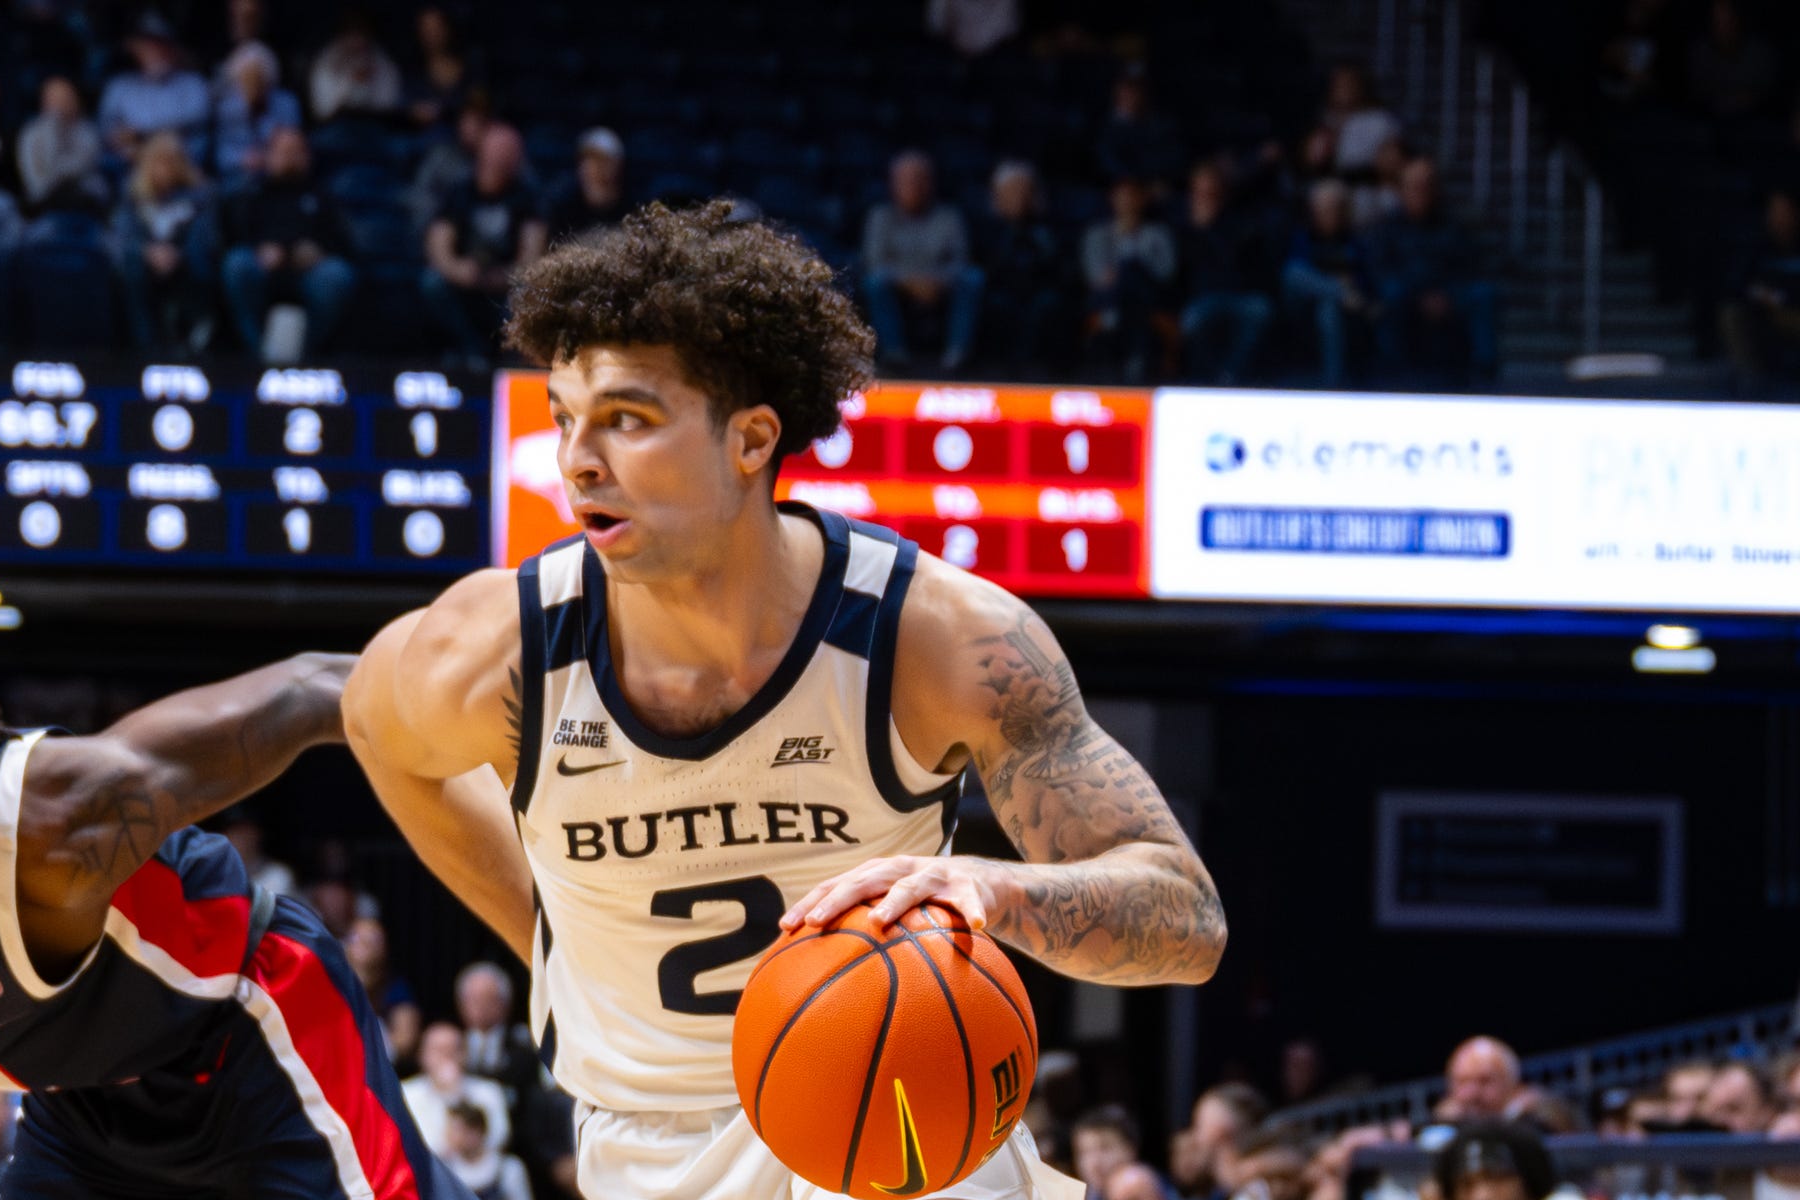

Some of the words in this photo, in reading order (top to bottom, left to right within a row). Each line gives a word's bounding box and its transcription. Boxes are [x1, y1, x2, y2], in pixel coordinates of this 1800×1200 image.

[558, 718, 577, 733] BE
[580, 720, 608, 736] THE
[553, 732, 609, 748] CHANGE
[779, 735, 825, 750] BIG
[773, 748, 836, 761] EAST
[560, 801, 861, 862] BUTLER
[649, 874, 787, 1016] 2
